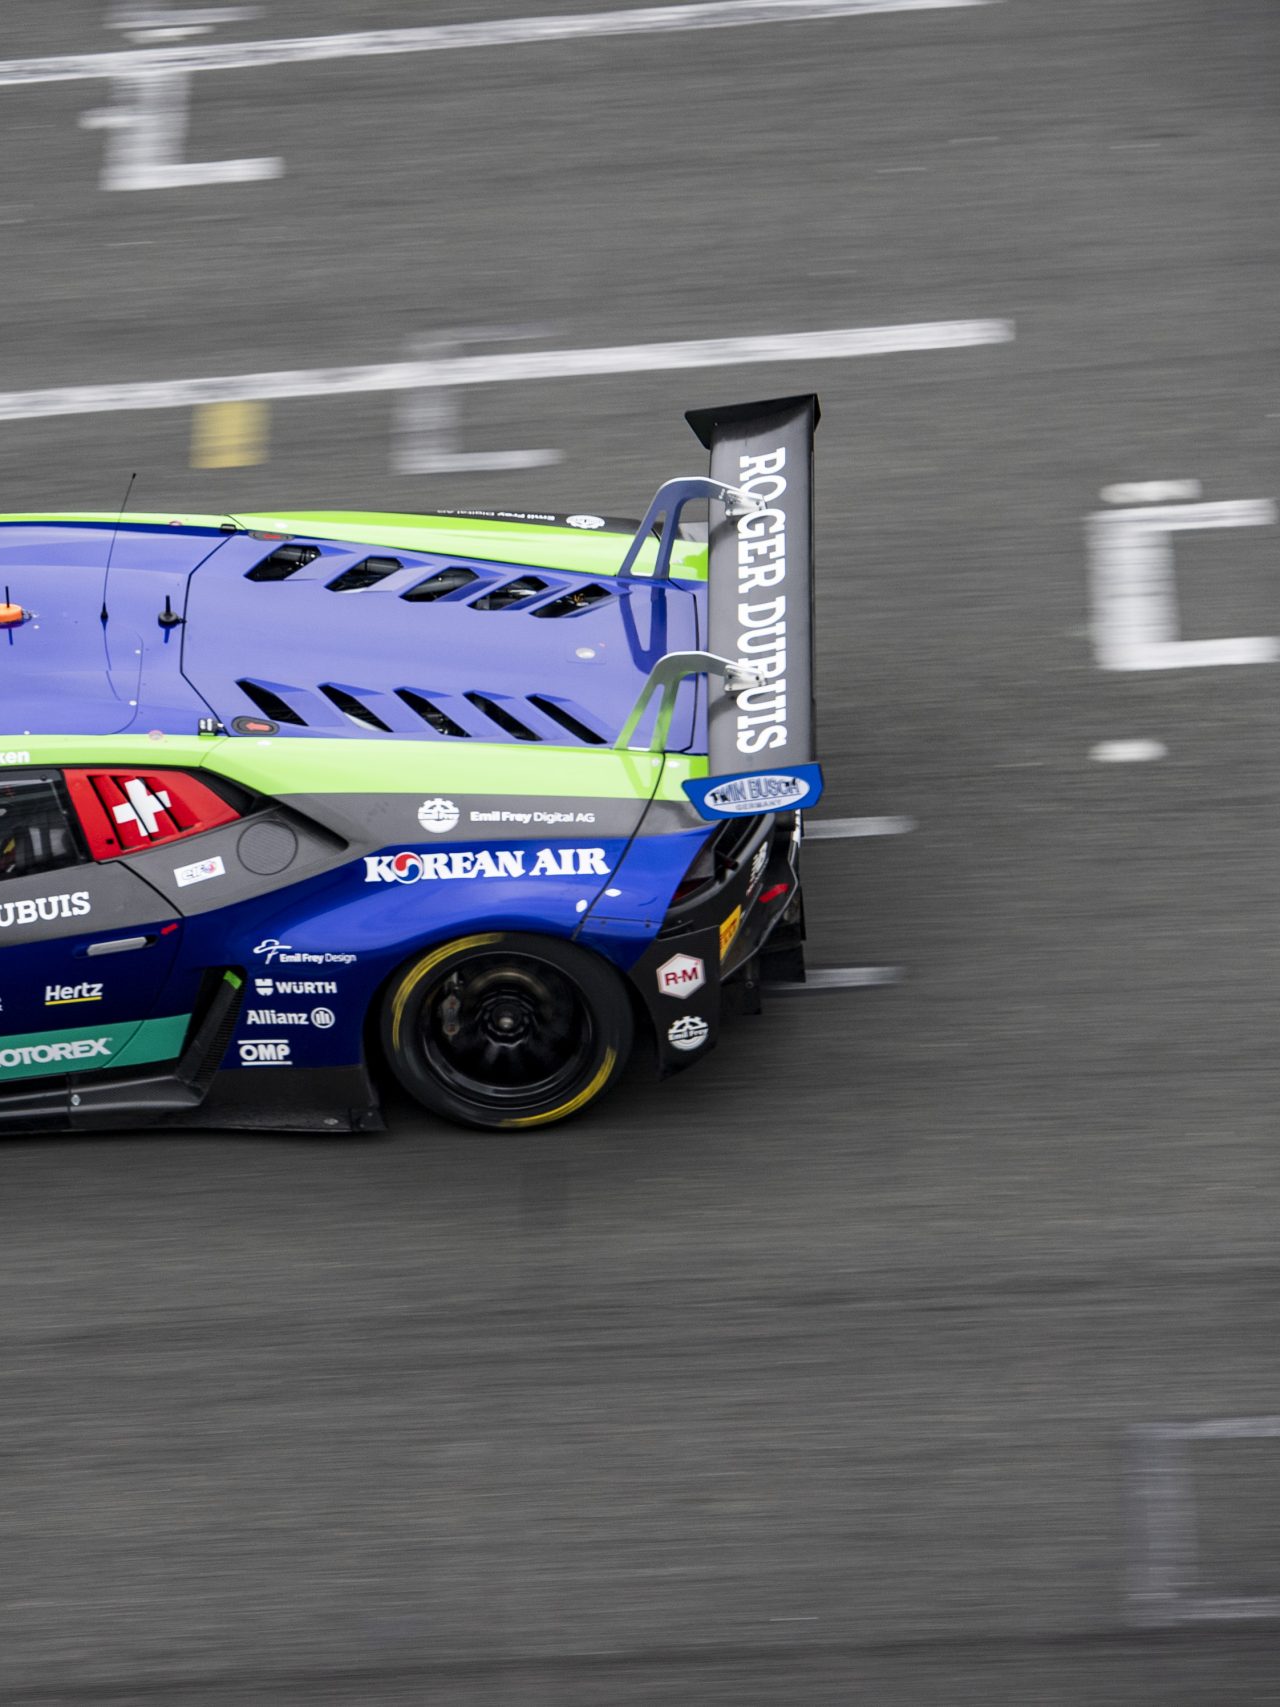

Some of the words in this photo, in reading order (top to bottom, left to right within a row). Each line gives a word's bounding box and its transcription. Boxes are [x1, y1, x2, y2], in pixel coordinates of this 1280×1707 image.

[470, 811, 501, 822] Emil
[502, 811, 532, 824] Frey
[533, 812, 574, 825] Digital
[575, 813, 596, 823] AG
[529, 848, 611, 876] AIR
[280, 953, 301, 963] Emil
[302, 953, 324, 965] Frey
[325, 953, 357, 964] Design
[665, 967, 698, 986] R-M
[44, 982, 104, 1002] Hertz
[246, 1009, 310, 1025] Allianz
[240, 1044, 291, 1061] OMP
